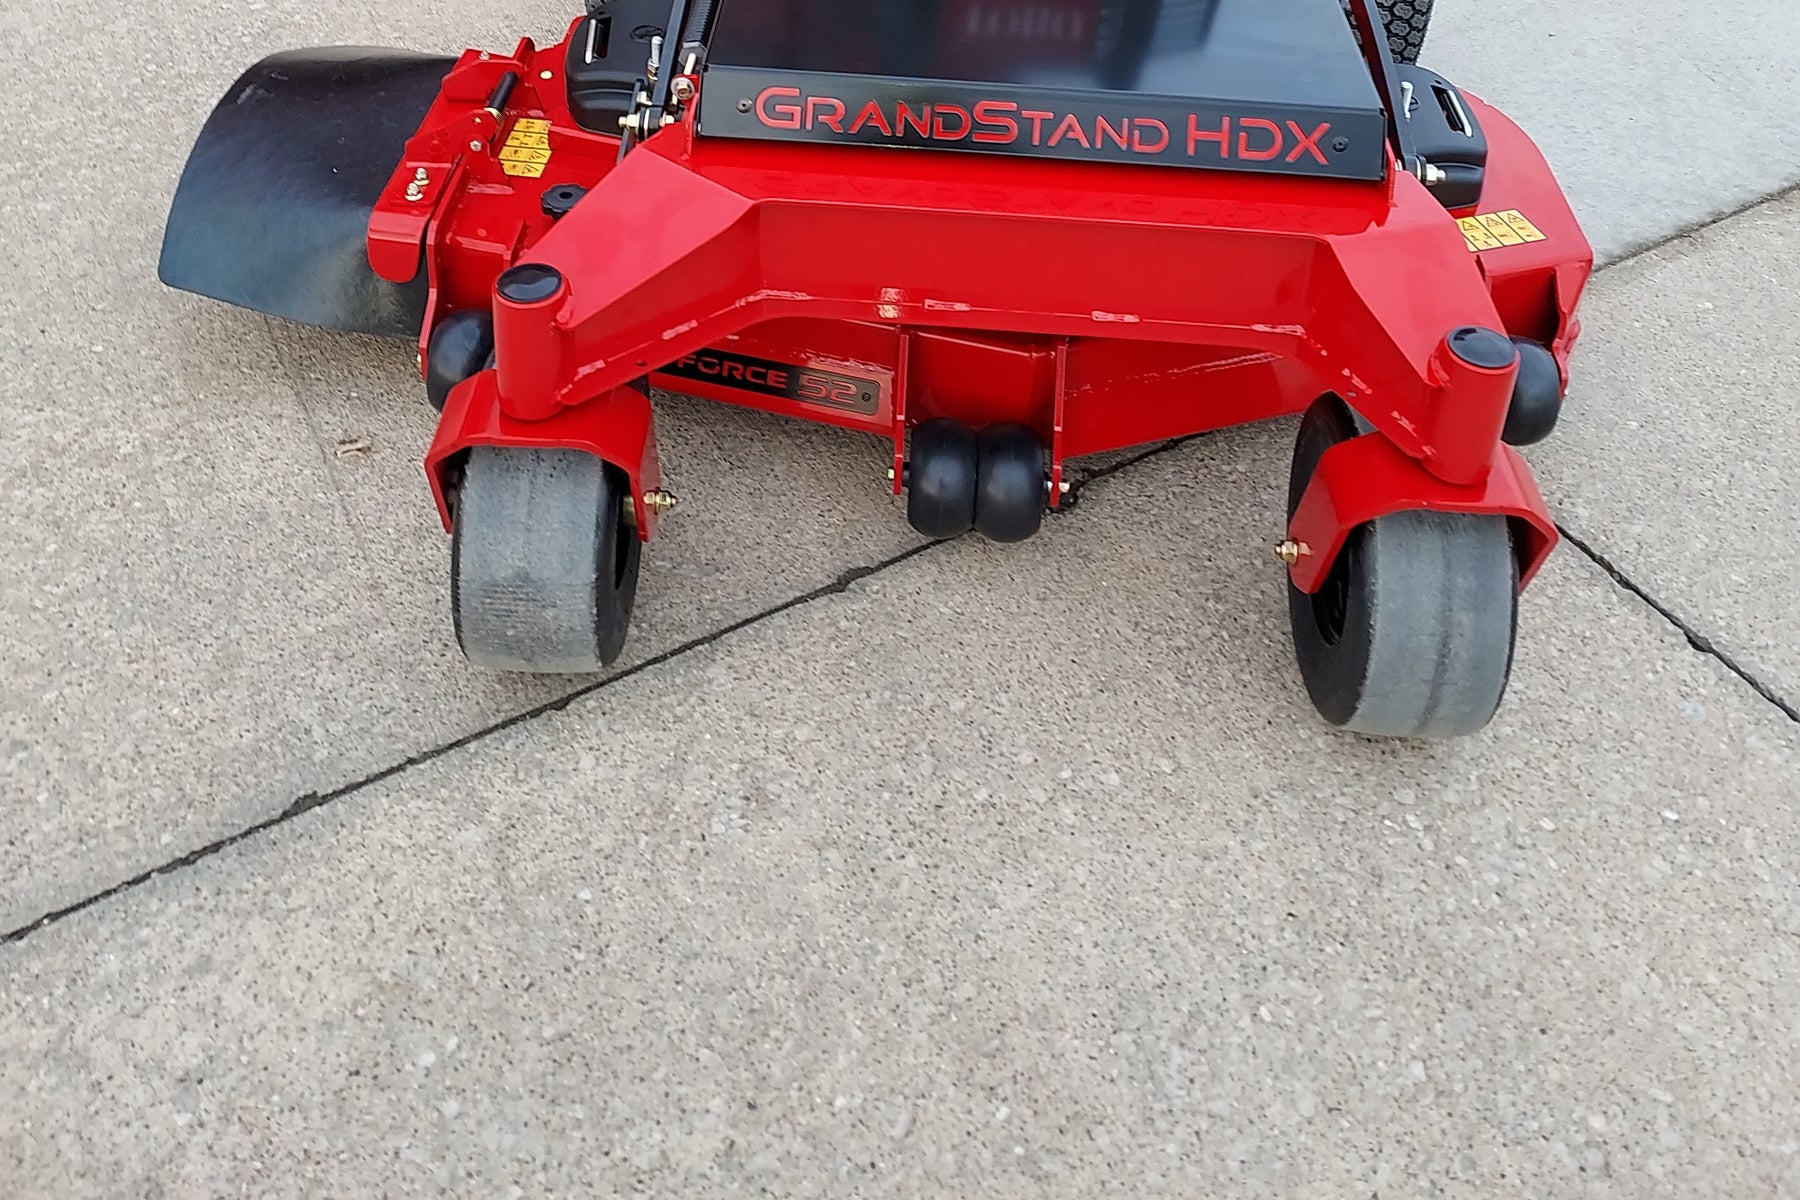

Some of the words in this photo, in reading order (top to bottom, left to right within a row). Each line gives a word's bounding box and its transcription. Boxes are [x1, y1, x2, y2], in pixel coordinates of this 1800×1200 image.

[1186, 113, 1331, 166] HDX
[677, 354, 789, 389] FORCE
[796, 373, 858, 405] 52
